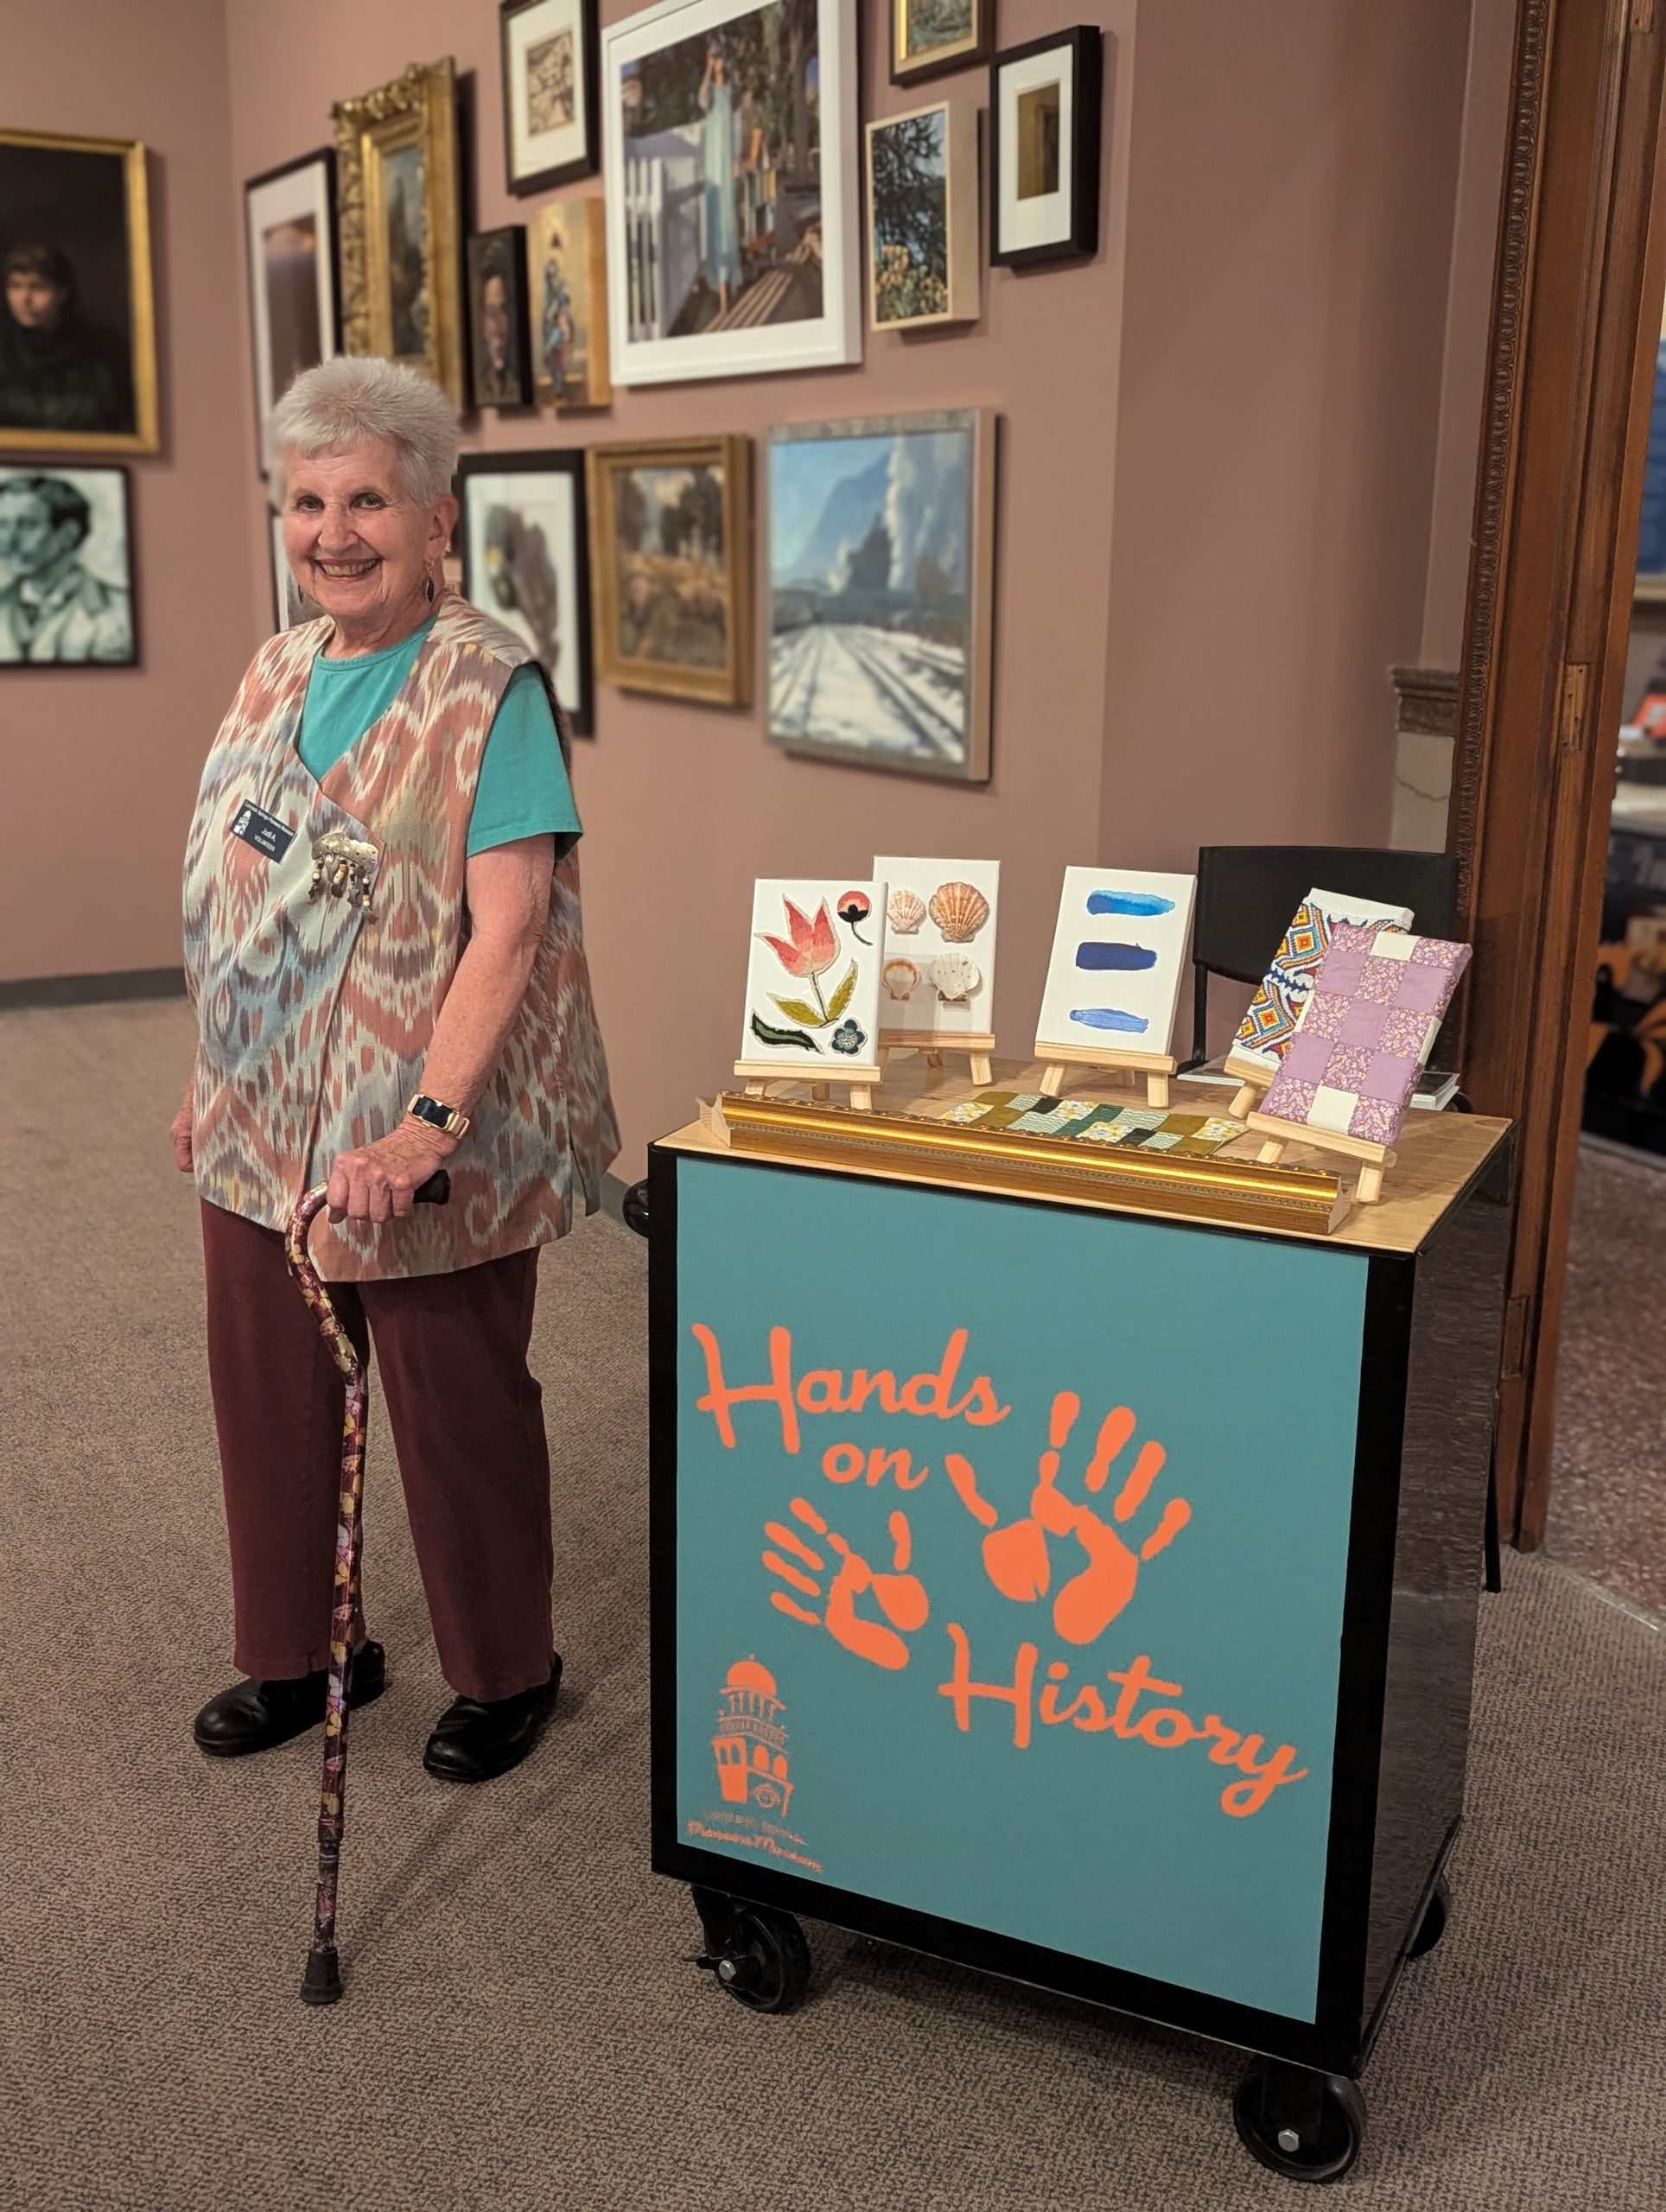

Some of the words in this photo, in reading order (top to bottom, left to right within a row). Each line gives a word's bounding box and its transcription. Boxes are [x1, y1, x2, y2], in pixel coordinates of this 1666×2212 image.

[254, 834, 276, 852] VOLUNTEER
[692, 1323, 1011, 1453] Hands
[822, 1442, 929, 1491] on
[938, 1621, 1309, 1818] History
